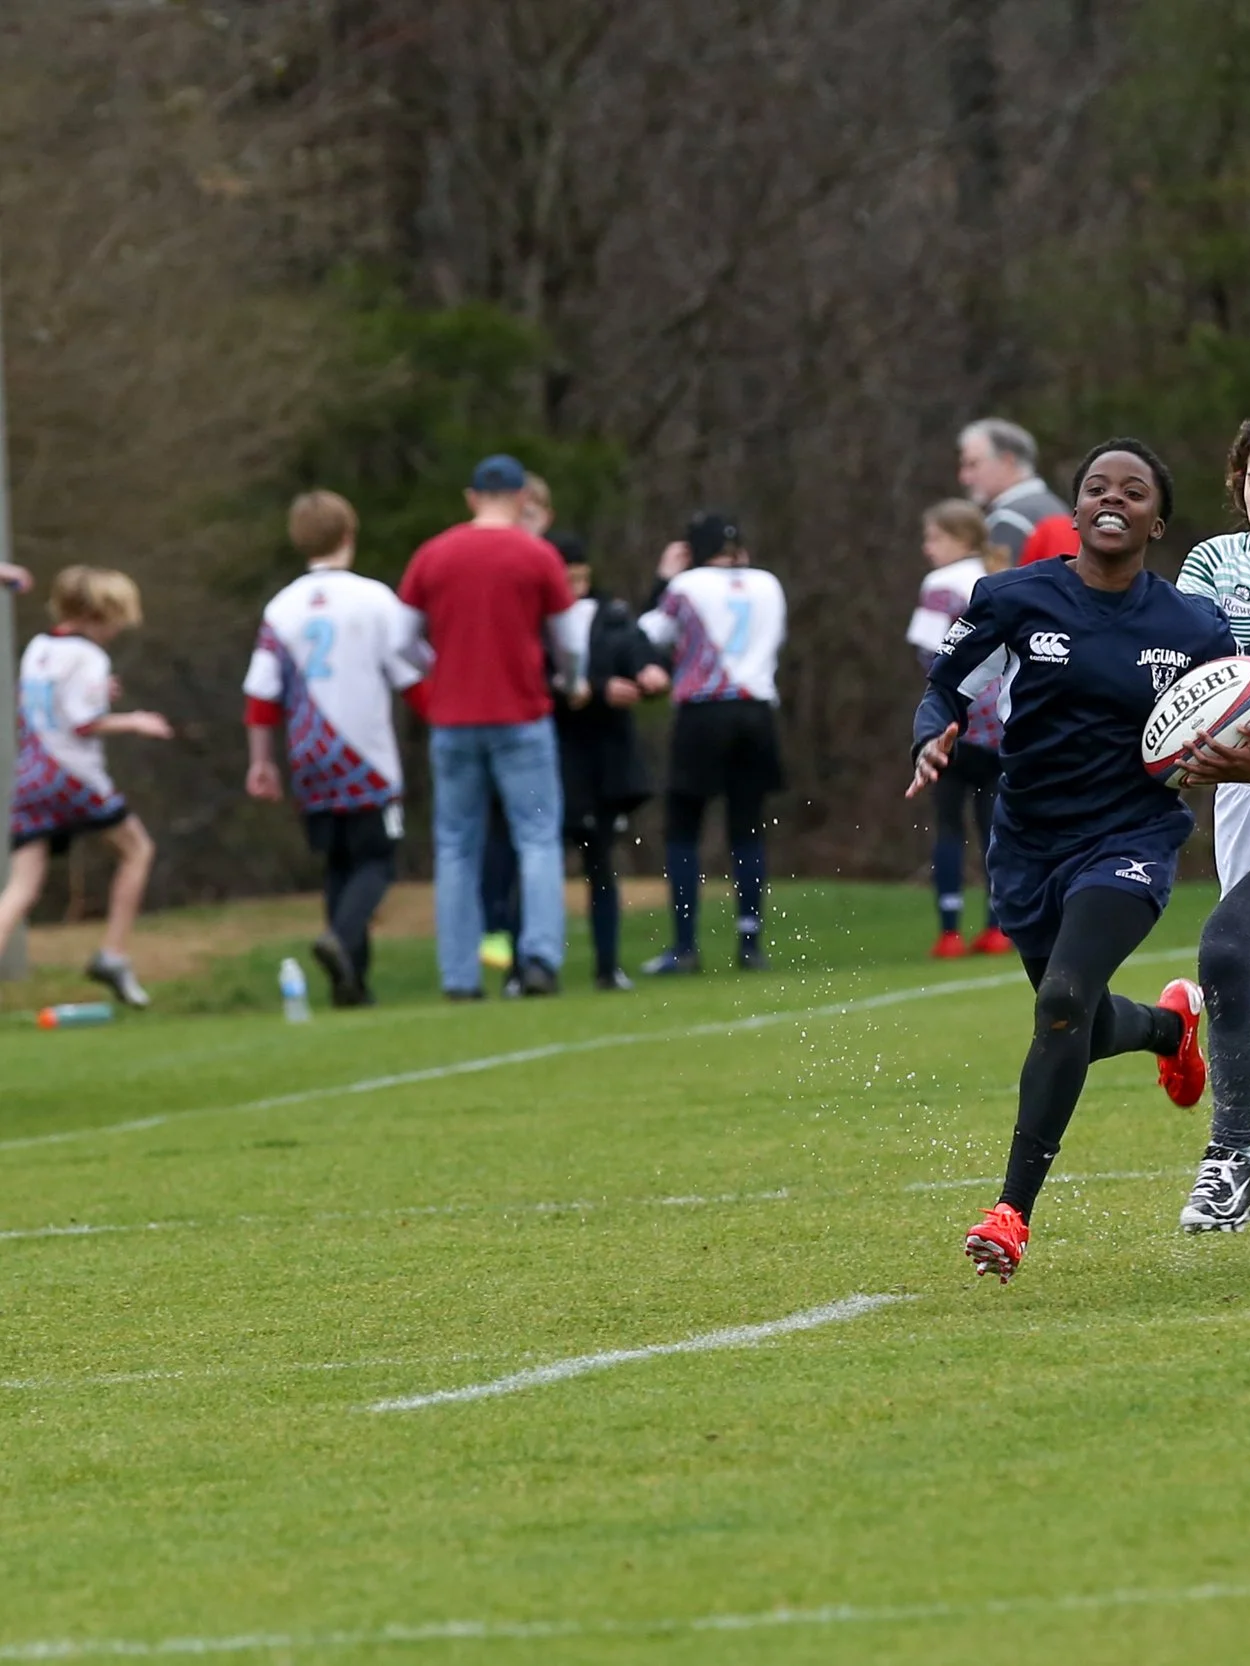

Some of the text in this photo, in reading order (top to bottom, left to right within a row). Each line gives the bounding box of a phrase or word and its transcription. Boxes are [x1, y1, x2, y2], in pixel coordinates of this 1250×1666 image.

[303, 617, 334, 679] 2
[726, 599, 750, 655] 7
[1136, 648, 1191, 669] JAGUARS
[1145, 664, 1239, 751] GILBERT
[1115, 870, 1151, 885] GILBERT
